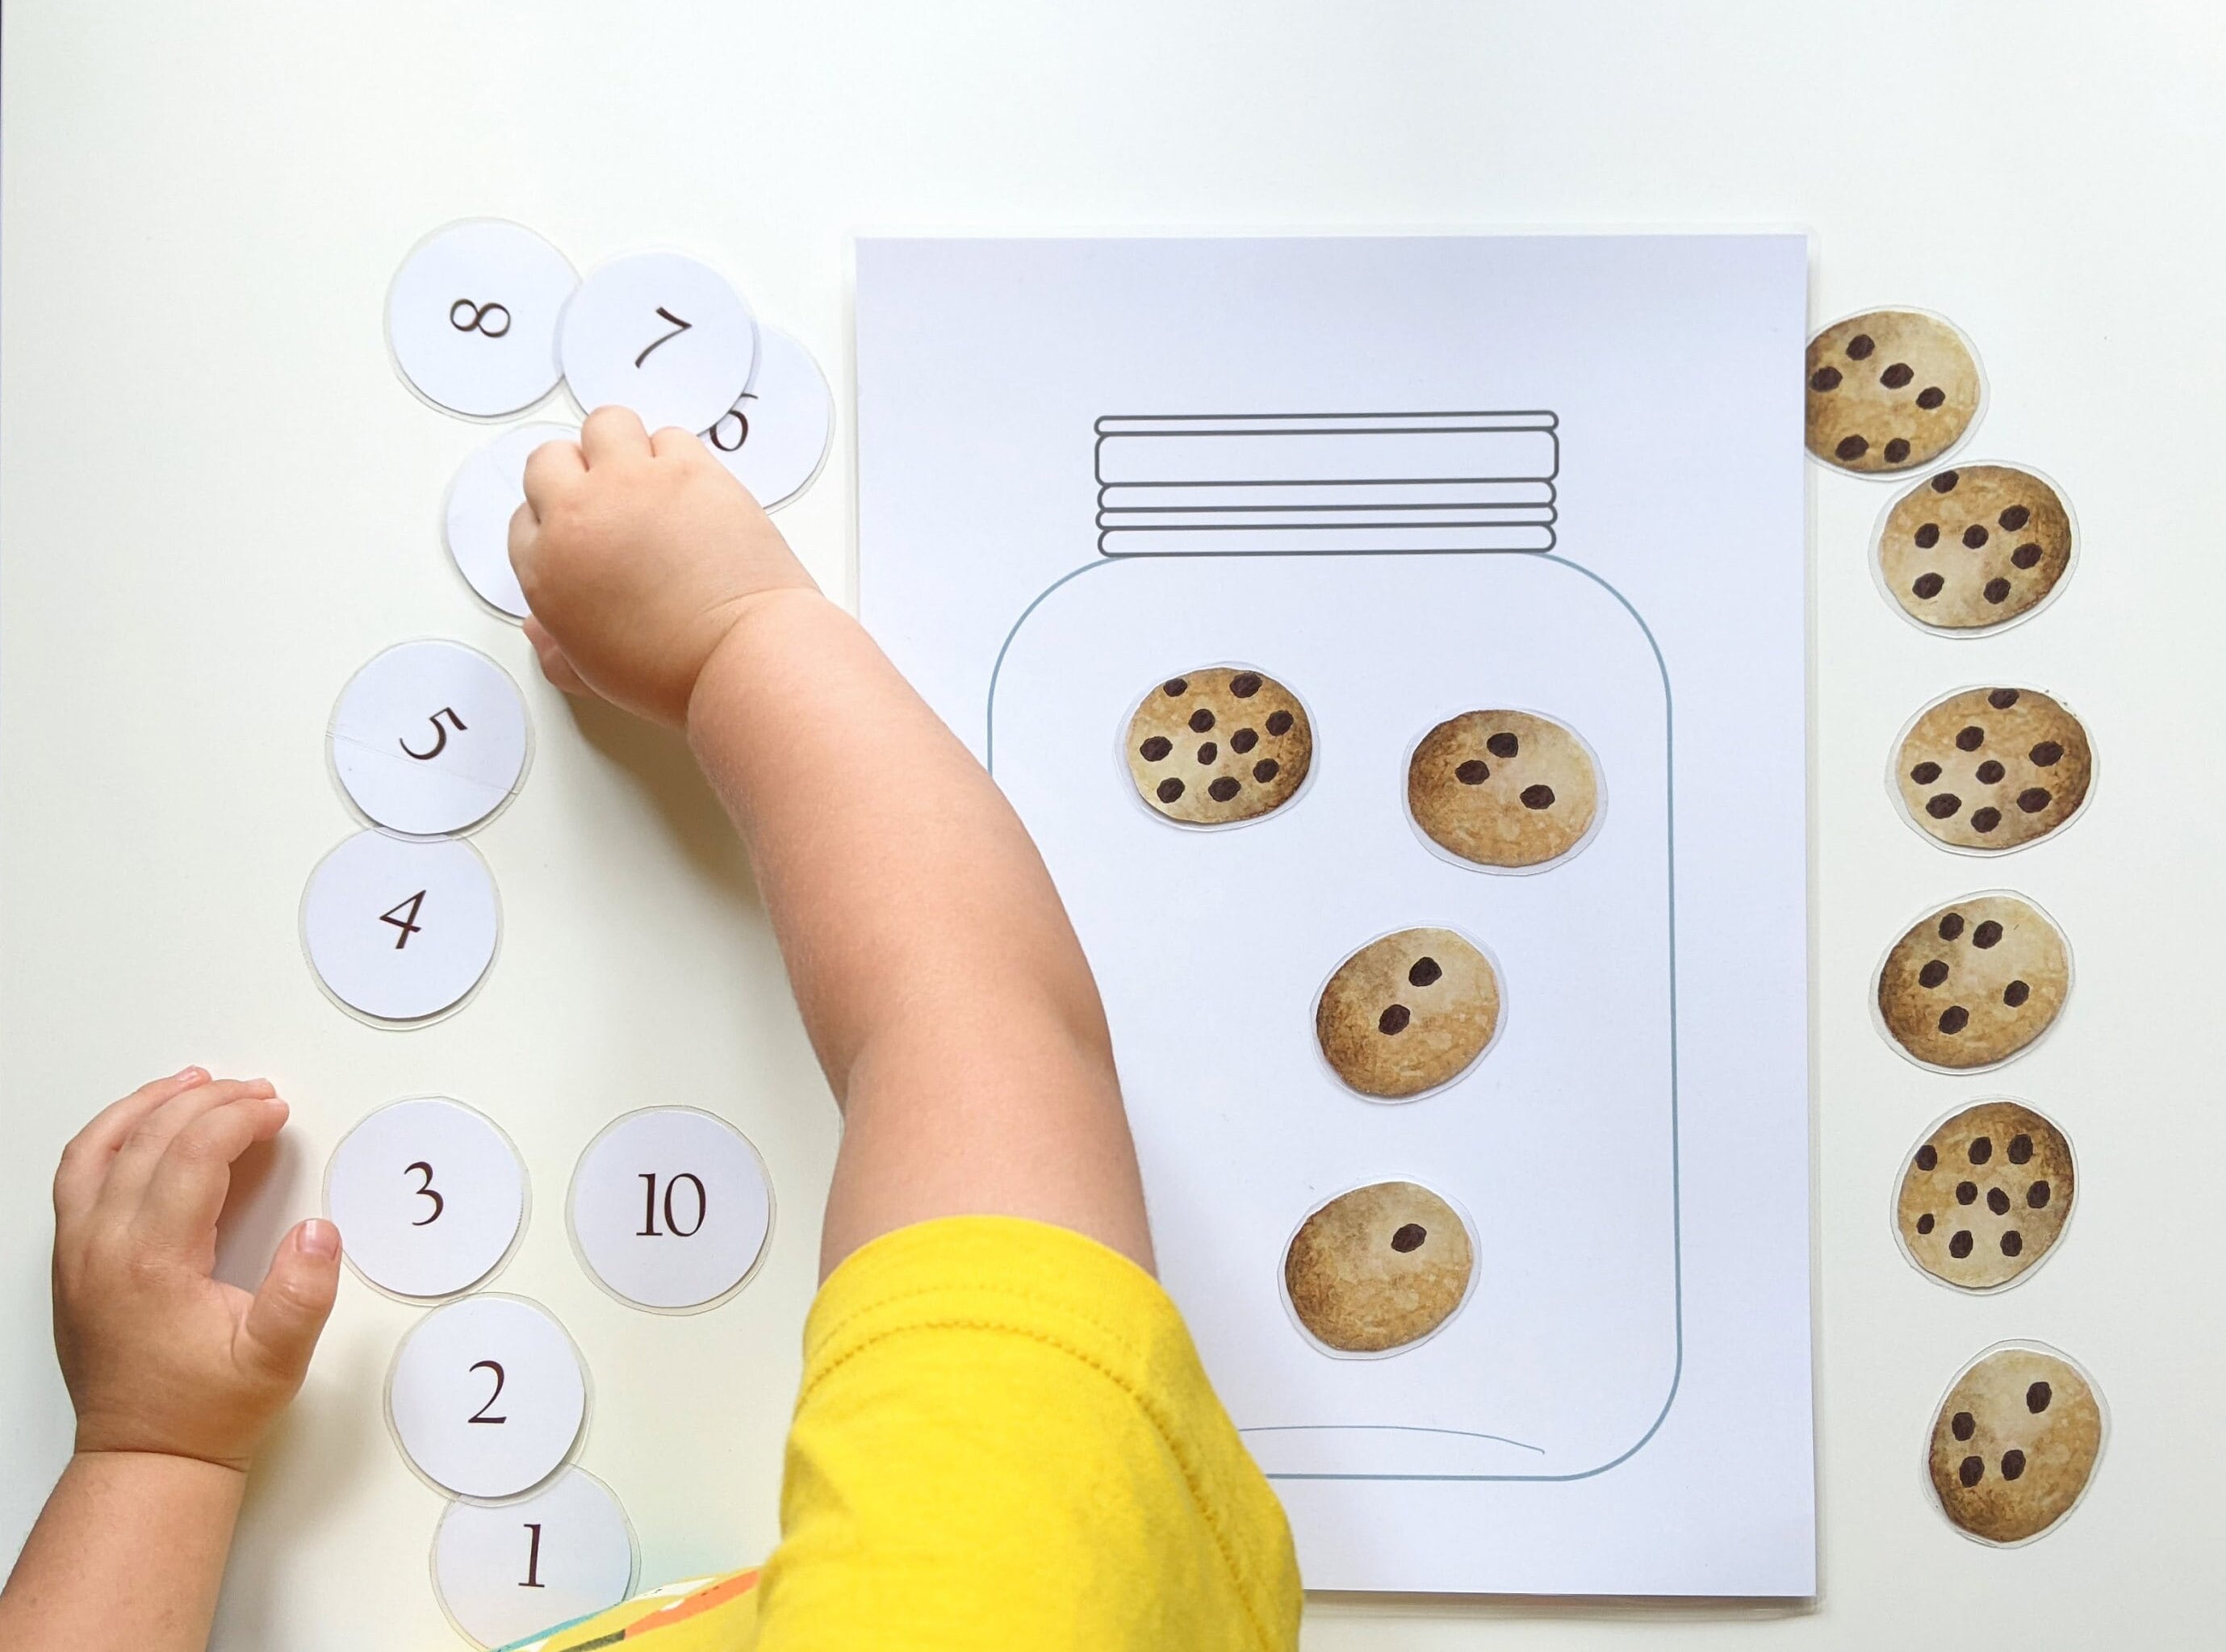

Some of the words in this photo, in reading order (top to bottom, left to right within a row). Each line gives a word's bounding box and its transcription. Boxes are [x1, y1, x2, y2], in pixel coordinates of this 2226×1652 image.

[450, 298, 511, 338] 8
[634, 306, 692, 369] 7
[709, 392, 759, 453] 6
[399, 706, 469, 761] 5
[379, 889, 428, 951] 4
[403, 1161, 445, 1227] 3
[635, 1172, 707, 1238] 10
[467, 1359, 508, 1425] 2
[517, 1523, 546, 1589] 1
